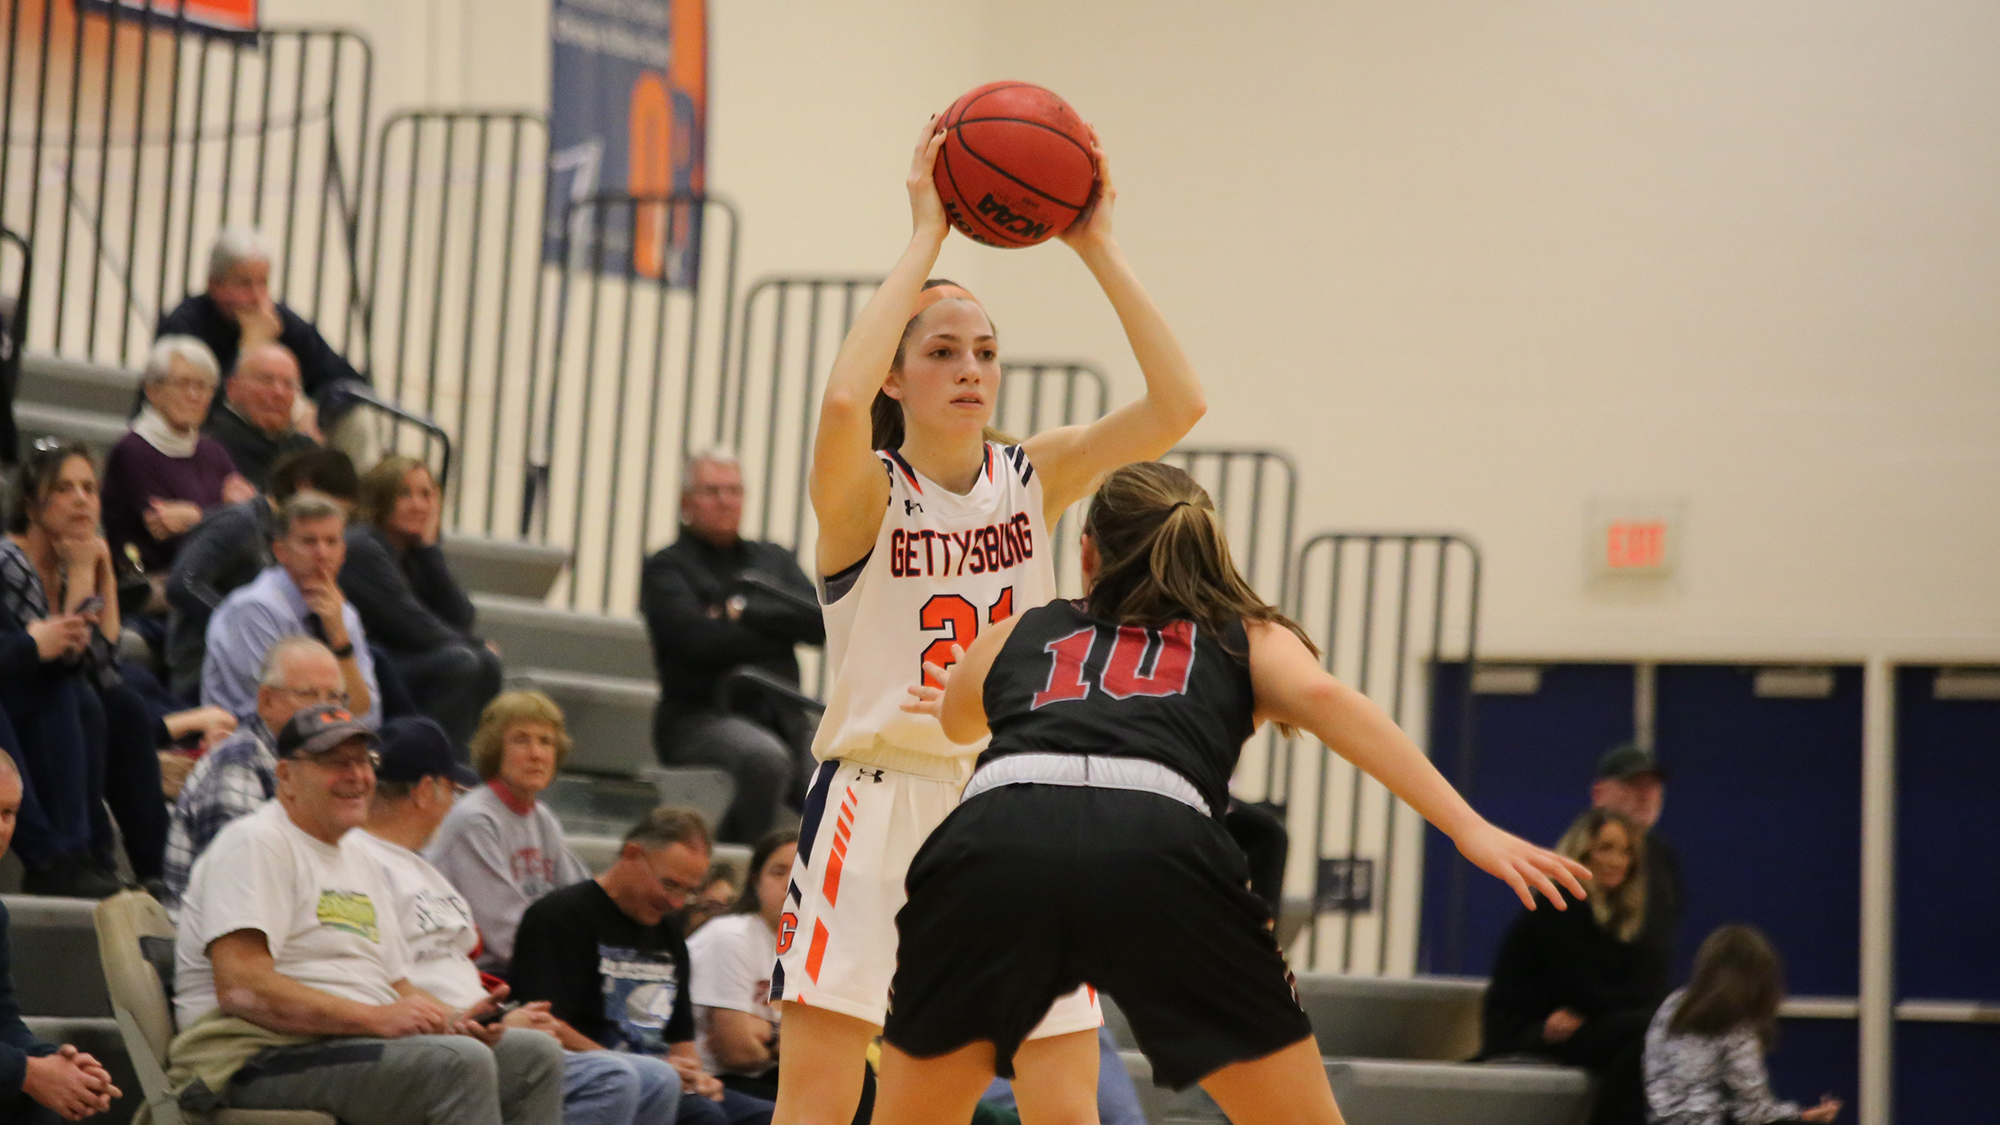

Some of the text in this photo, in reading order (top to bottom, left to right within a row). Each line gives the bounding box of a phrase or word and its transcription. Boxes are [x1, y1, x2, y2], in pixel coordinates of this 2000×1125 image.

[976, 192, 1055, 240] NCAA
[1030, 619, 1197, 711] 10
[776, 912, 798, 955] G
